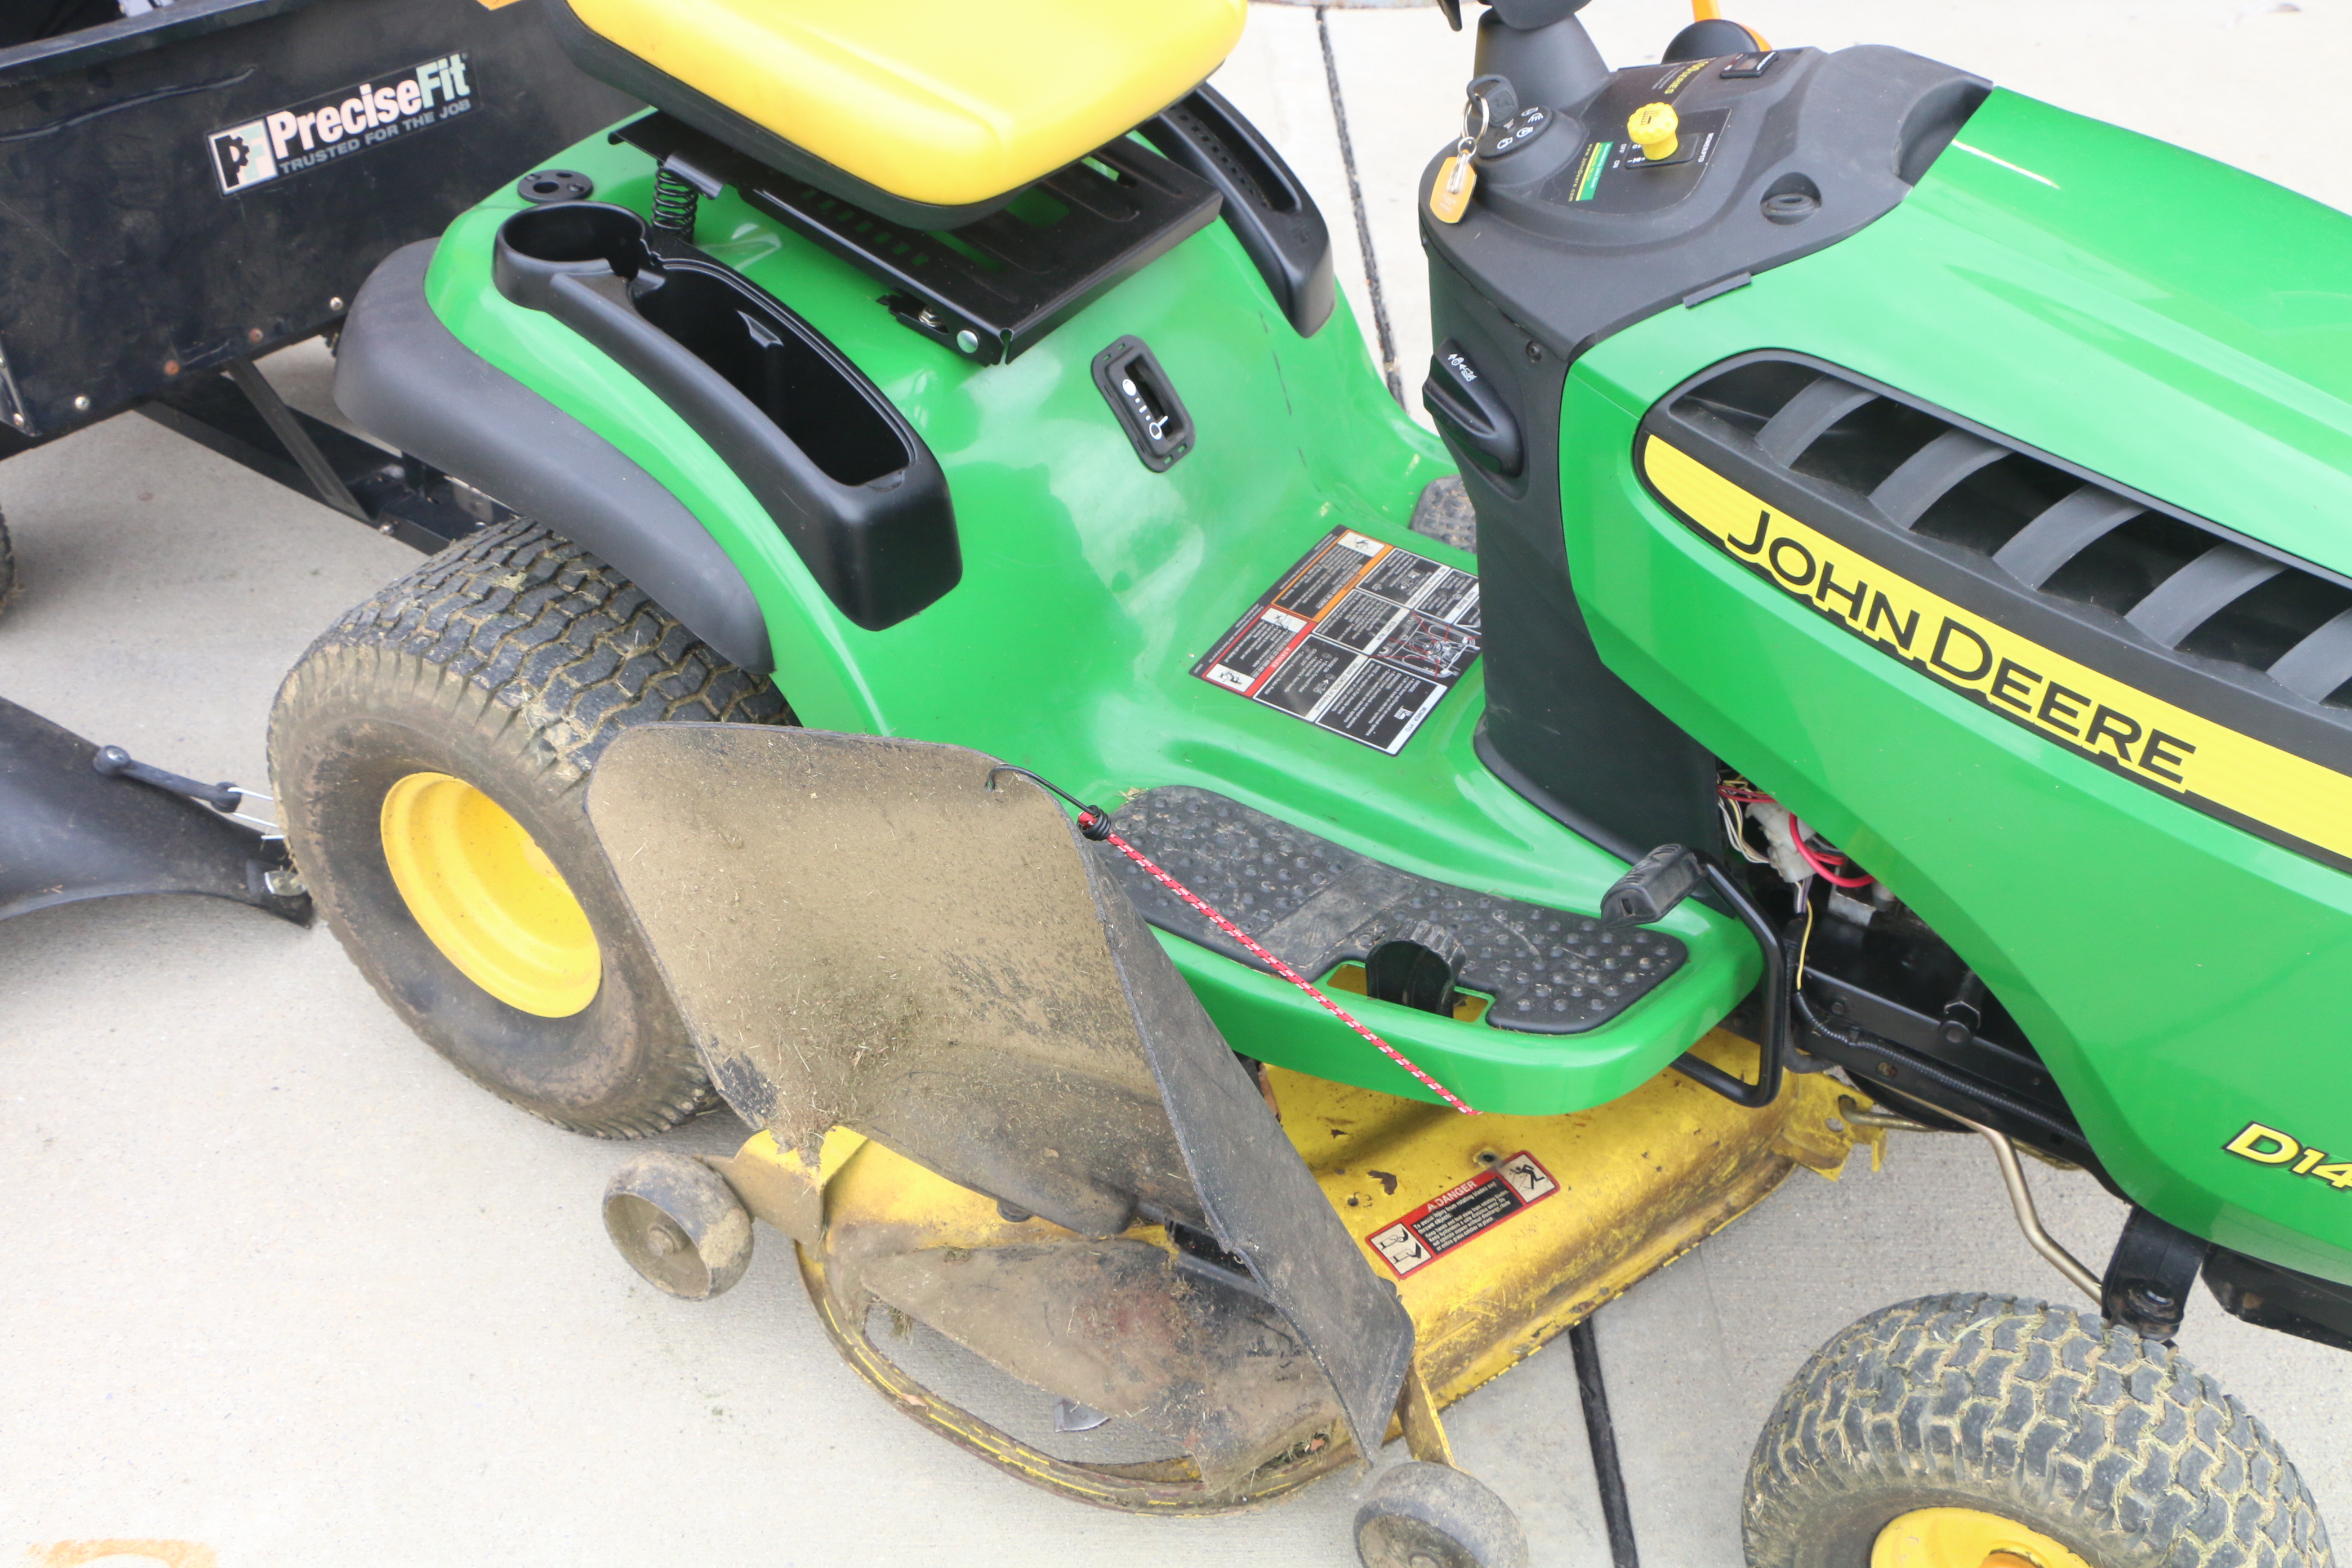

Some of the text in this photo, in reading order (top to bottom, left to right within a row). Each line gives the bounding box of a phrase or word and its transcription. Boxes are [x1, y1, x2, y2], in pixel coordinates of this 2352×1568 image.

[266, 54, 471, 159] PreciseFit
[279, 98, 471, 174] TRUSTED FOR THE JOB
[1270, 651, 1289, 667] DANGER
[1727, 509, 2197, 783] JOHN DEERE
[1412, 707, 1427, 721] MOWER
[1435, 1181, 1477, 1207] DANGER
